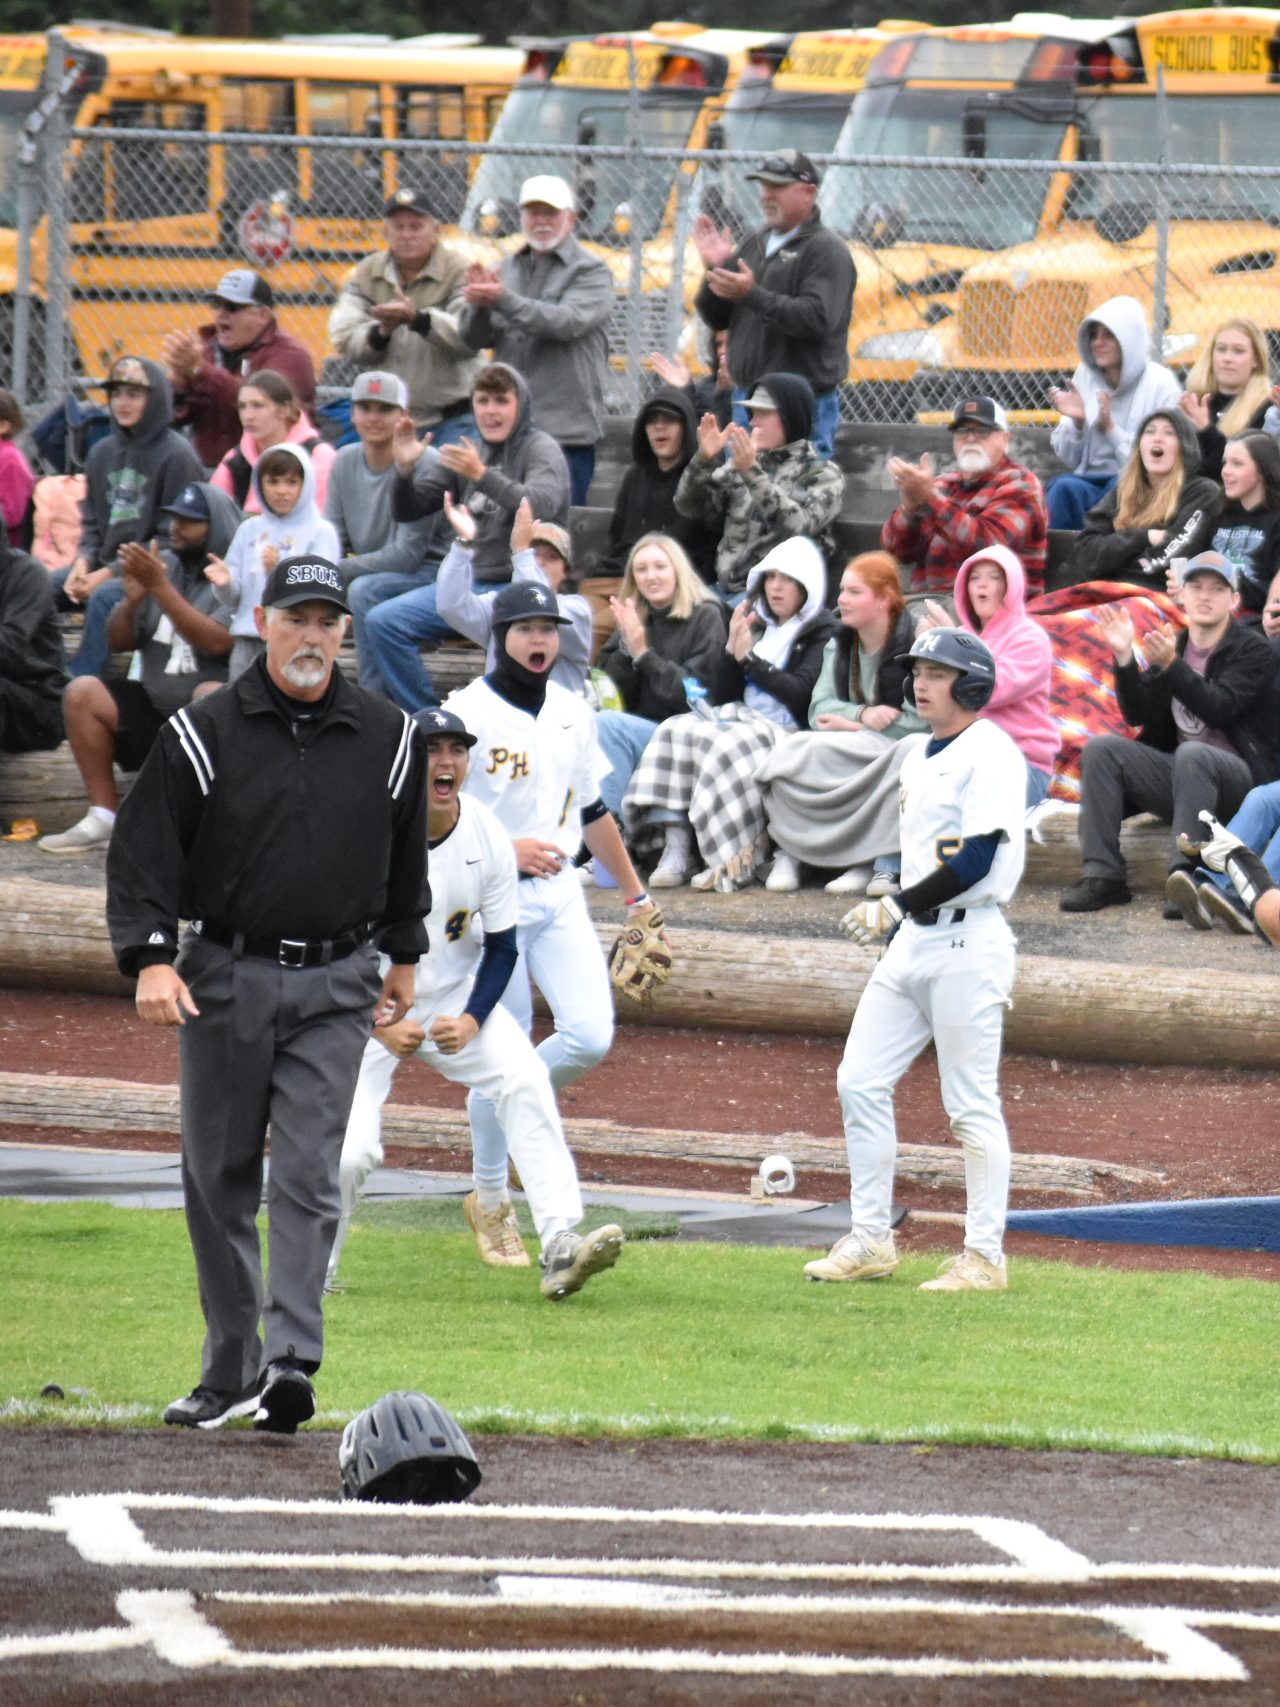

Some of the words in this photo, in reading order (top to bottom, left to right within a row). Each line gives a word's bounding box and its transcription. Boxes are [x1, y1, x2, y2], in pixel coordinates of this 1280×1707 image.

[1155, 34, 1216, 71] SCHOOL
[1229, 34, 1261, 71] BUS
[286, 564, 342, 591] SBUA
[486, 747, 529, 780] PH
[445, 908, 469, 944] 4
